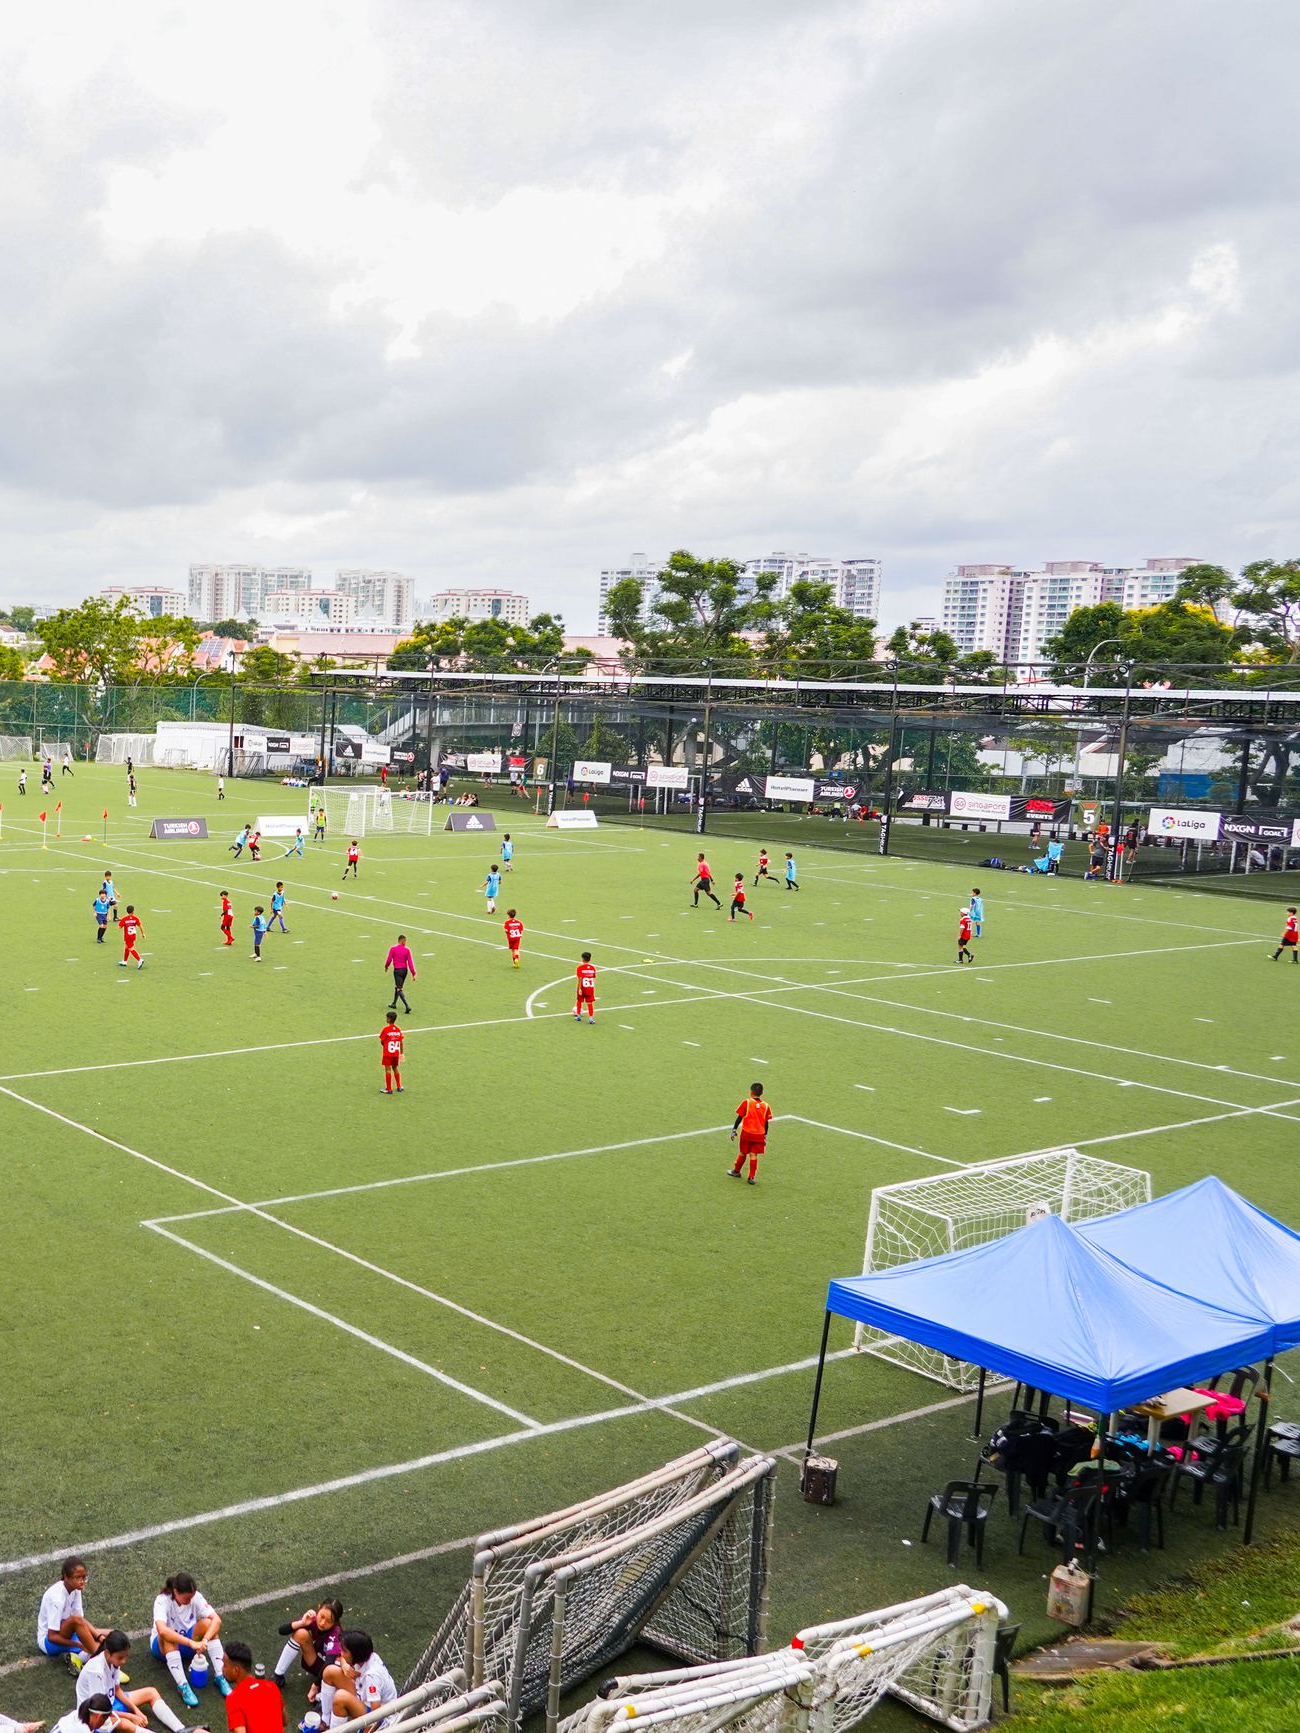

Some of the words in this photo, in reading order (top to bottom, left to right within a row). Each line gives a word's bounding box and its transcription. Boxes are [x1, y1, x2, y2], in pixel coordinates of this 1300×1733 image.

[536, 764, 544, 775] 6
[1083, 809, 1095, 824] 5
[1177, 820, 1206, 829] LaLiga
[1224, 823, 1256, 834] NXGN
